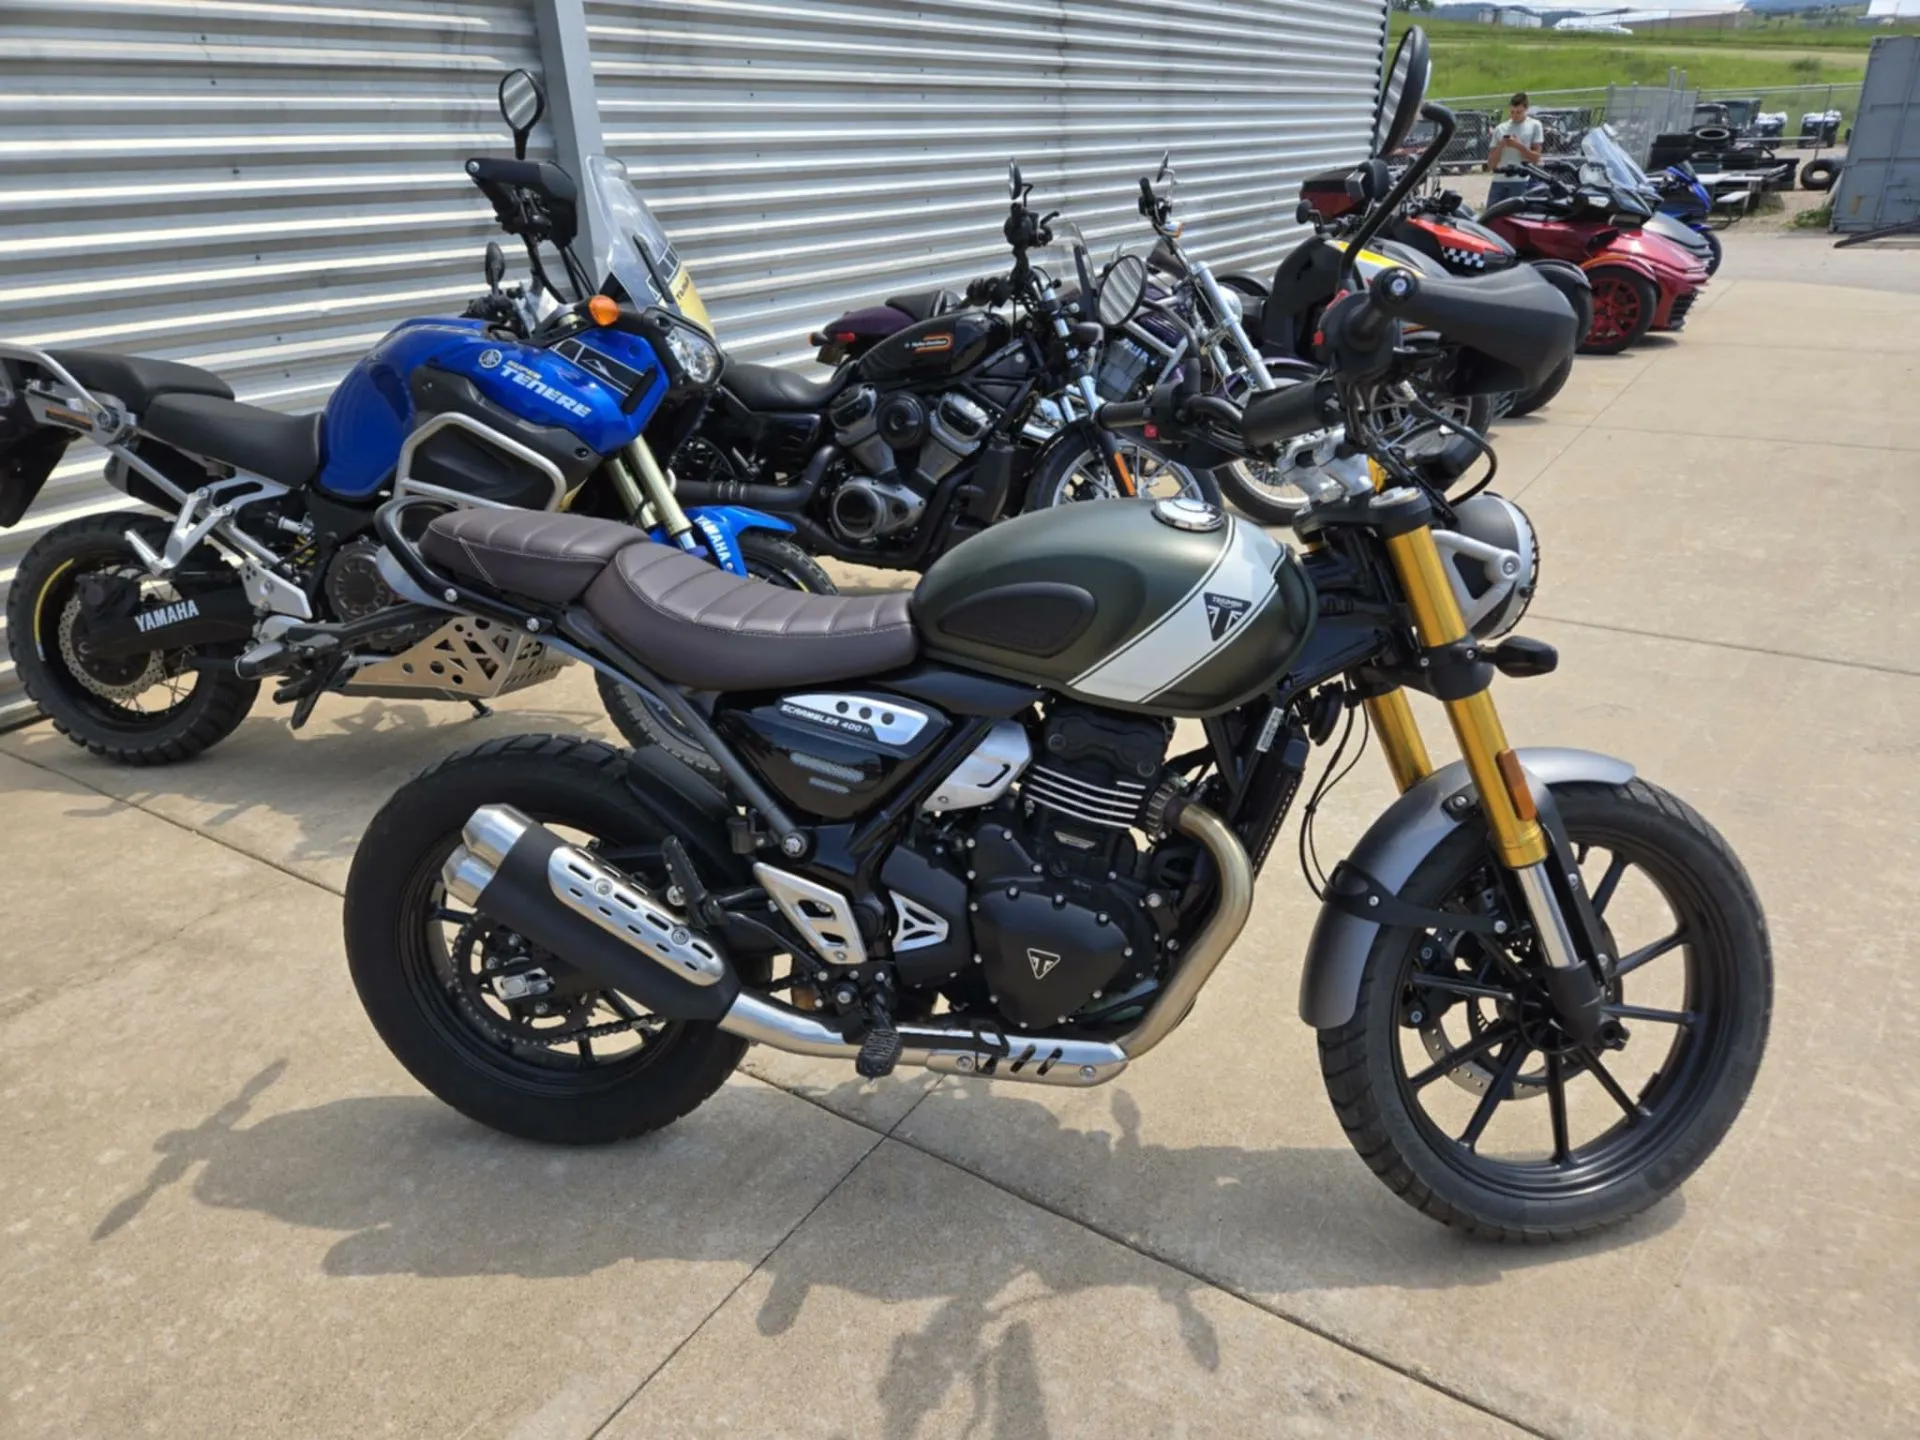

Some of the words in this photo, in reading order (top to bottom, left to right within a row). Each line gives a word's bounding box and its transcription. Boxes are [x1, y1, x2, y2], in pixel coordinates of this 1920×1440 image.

[694, 514, 731, 563] YAMAHA
[134, 600, 199, 633] YAMAHA
[780, 704, 840, 726] SCRAMBLER
[840, 721, 863, 732] 400
